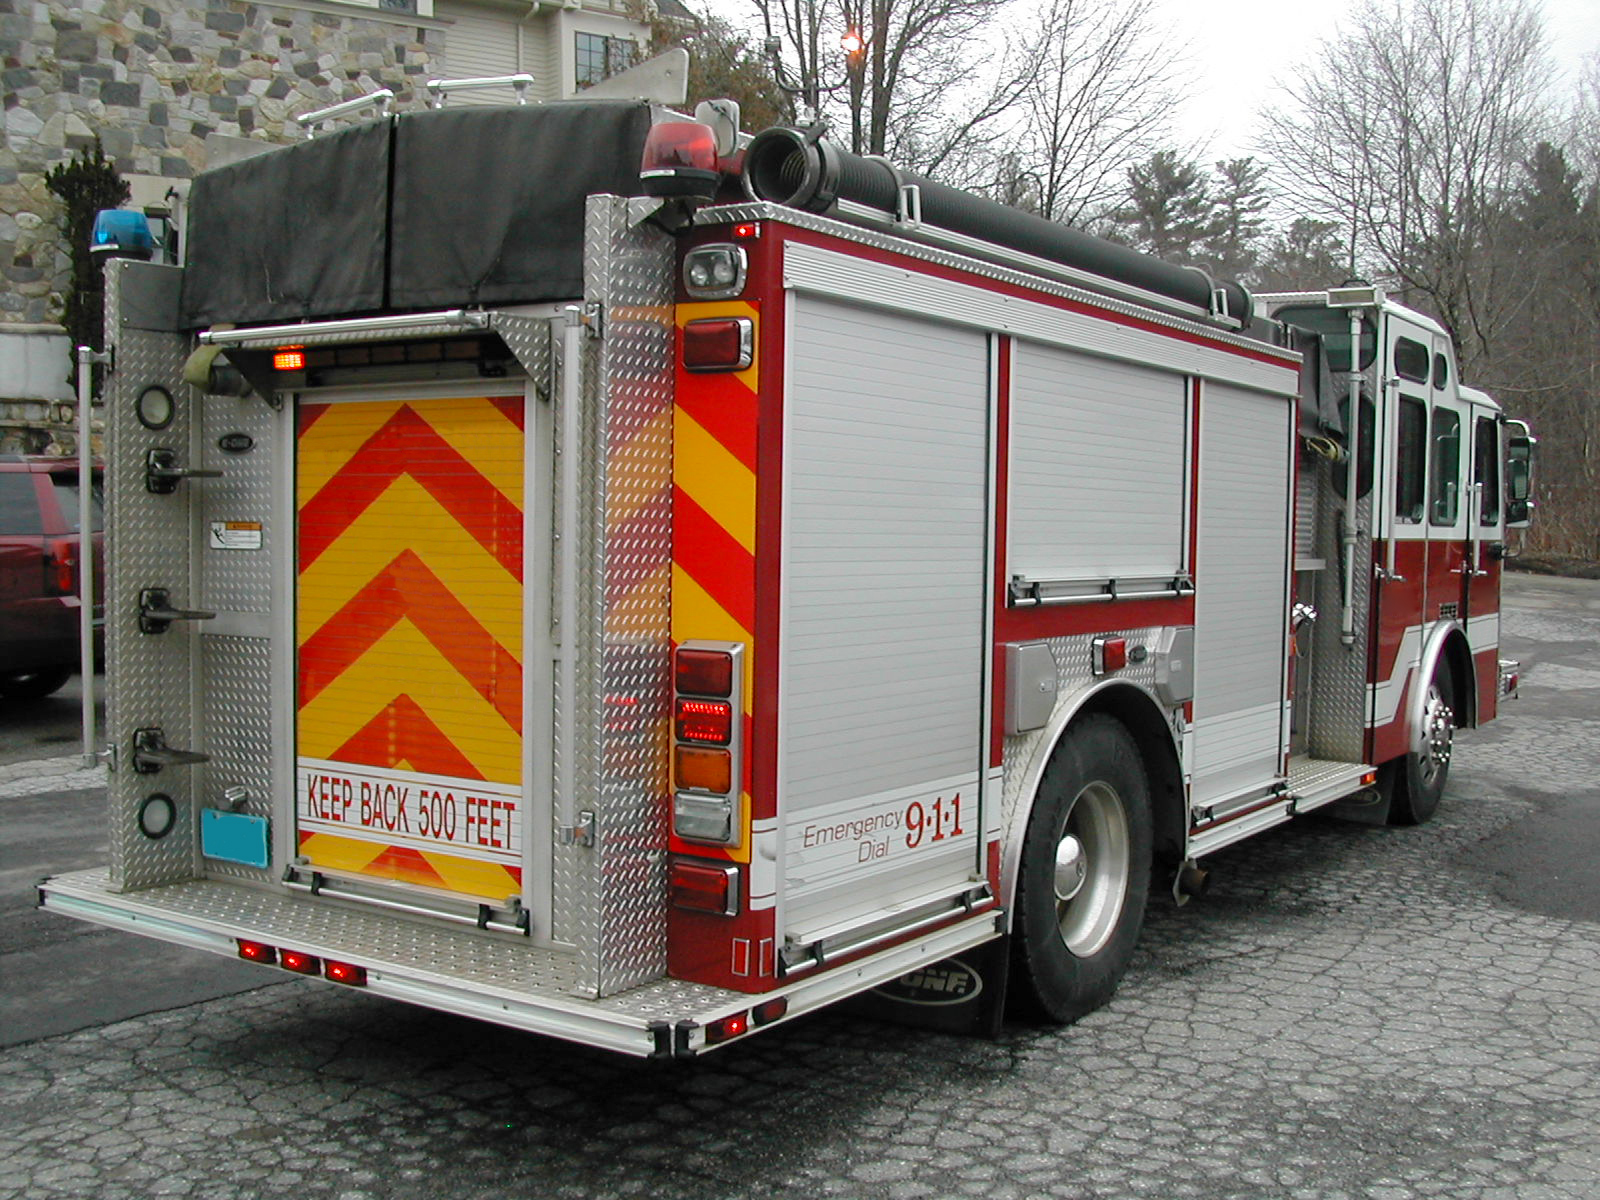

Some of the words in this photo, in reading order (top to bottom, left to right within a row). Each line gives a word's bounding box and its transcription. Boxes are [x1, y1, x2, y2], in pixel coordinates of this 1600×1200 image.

[308, 775, 353, 823] KEEP
[361, 782, 409, 833] BACK
[418, 790, 456, 842] 500
[466, 797, 515, 850] FEET
[804, 810, 903, 848] Emergency
[858, 836, 891, 863] Dial
